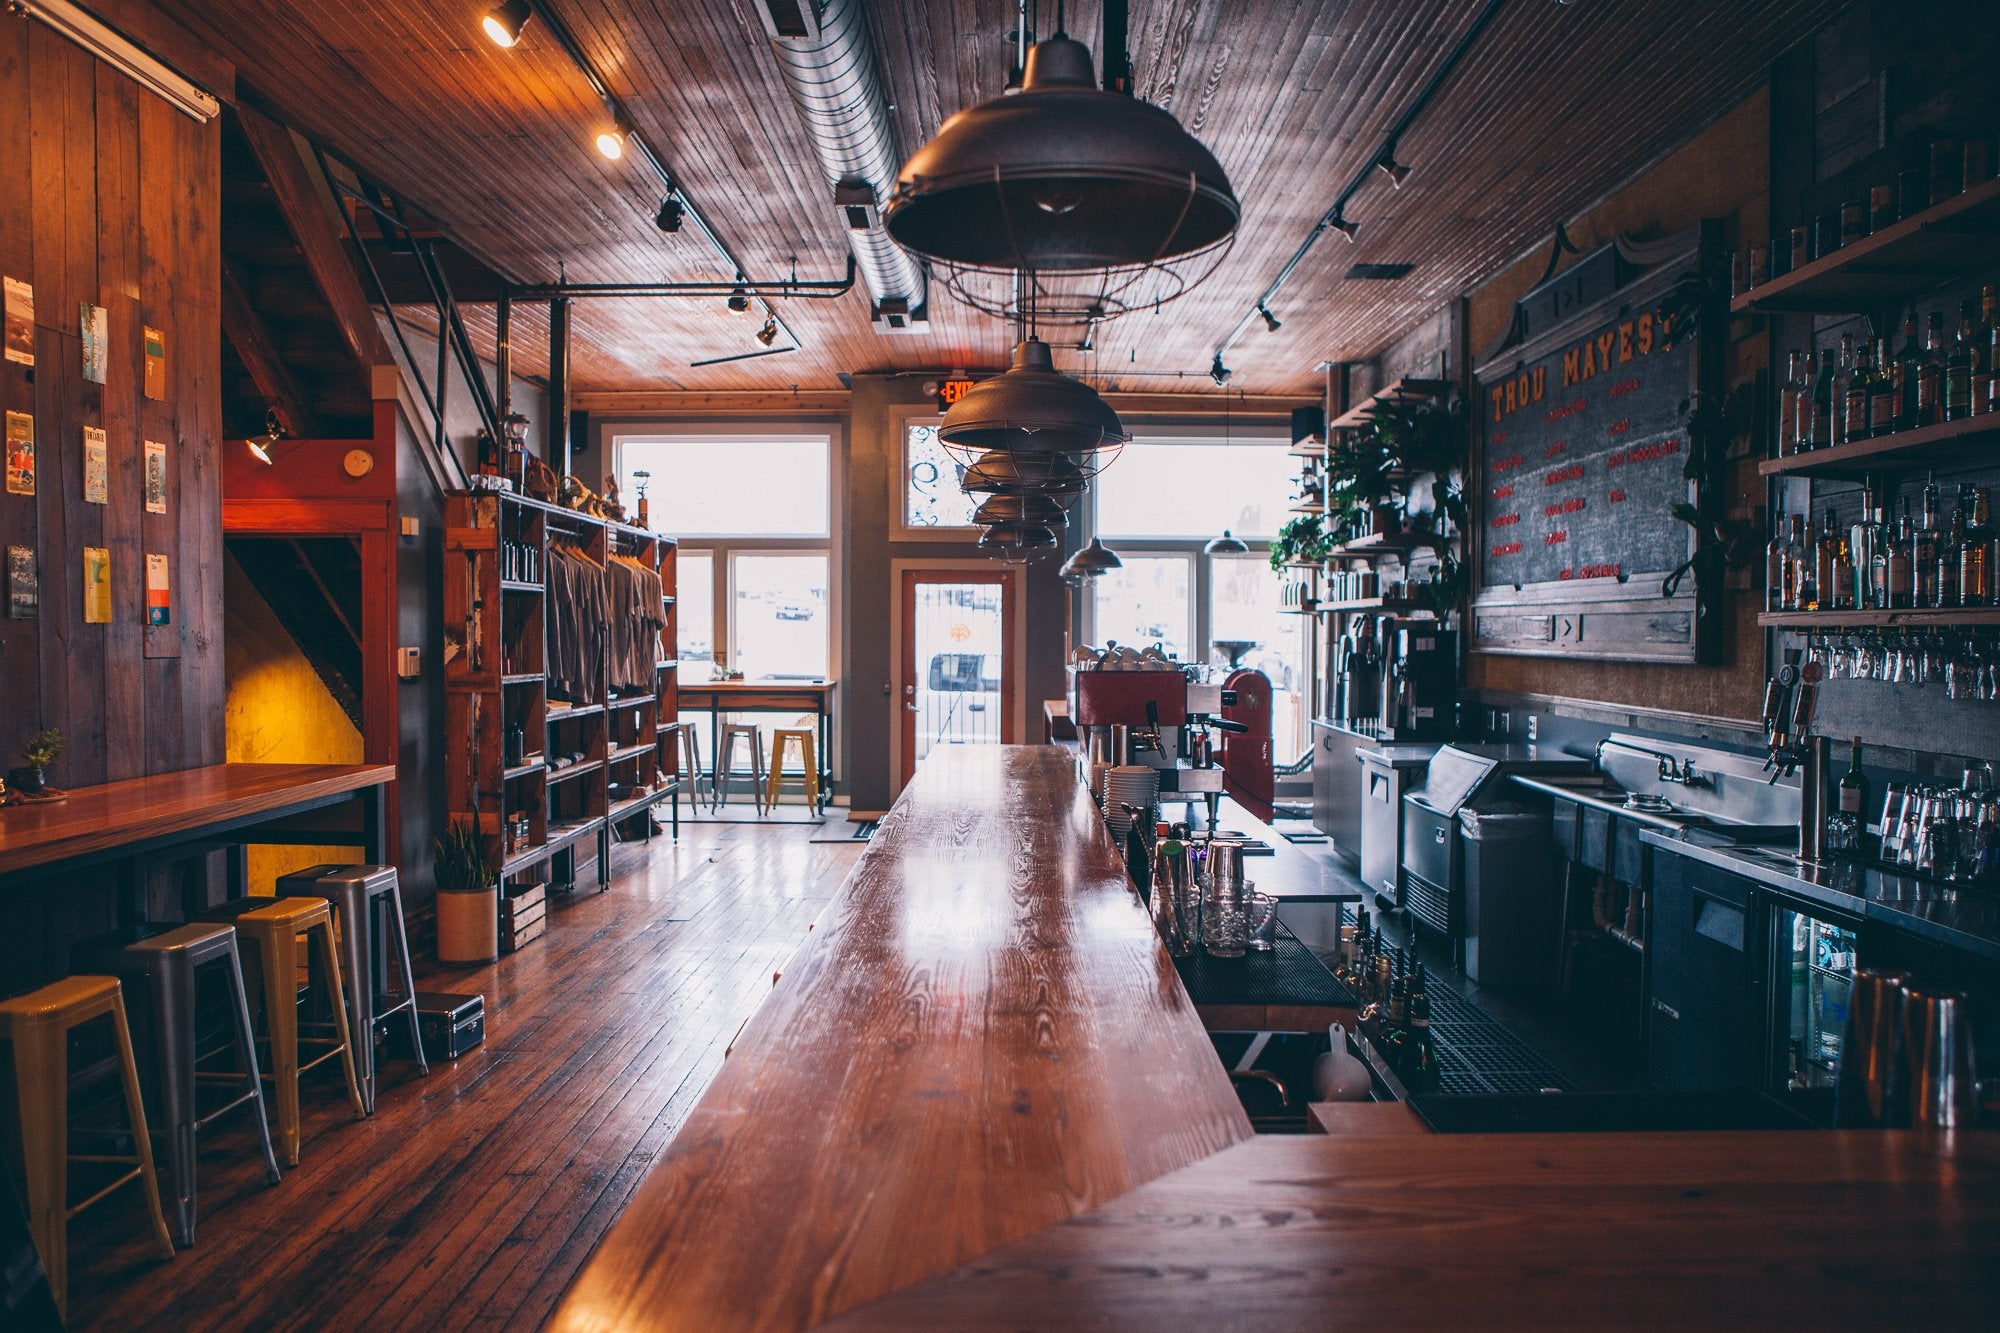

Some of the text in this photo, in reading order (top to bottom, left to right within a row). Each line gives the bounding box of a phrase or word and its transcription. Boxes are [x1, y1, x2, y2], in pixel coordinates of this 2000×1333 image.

[1491, 366, 1545, 424] THOU
[86, 430, 105, 443] ONTARIO
[1626, 438, 1679, 465] CHOCOLATE
[1578, 562, 1620, 579] COCKTAILS
